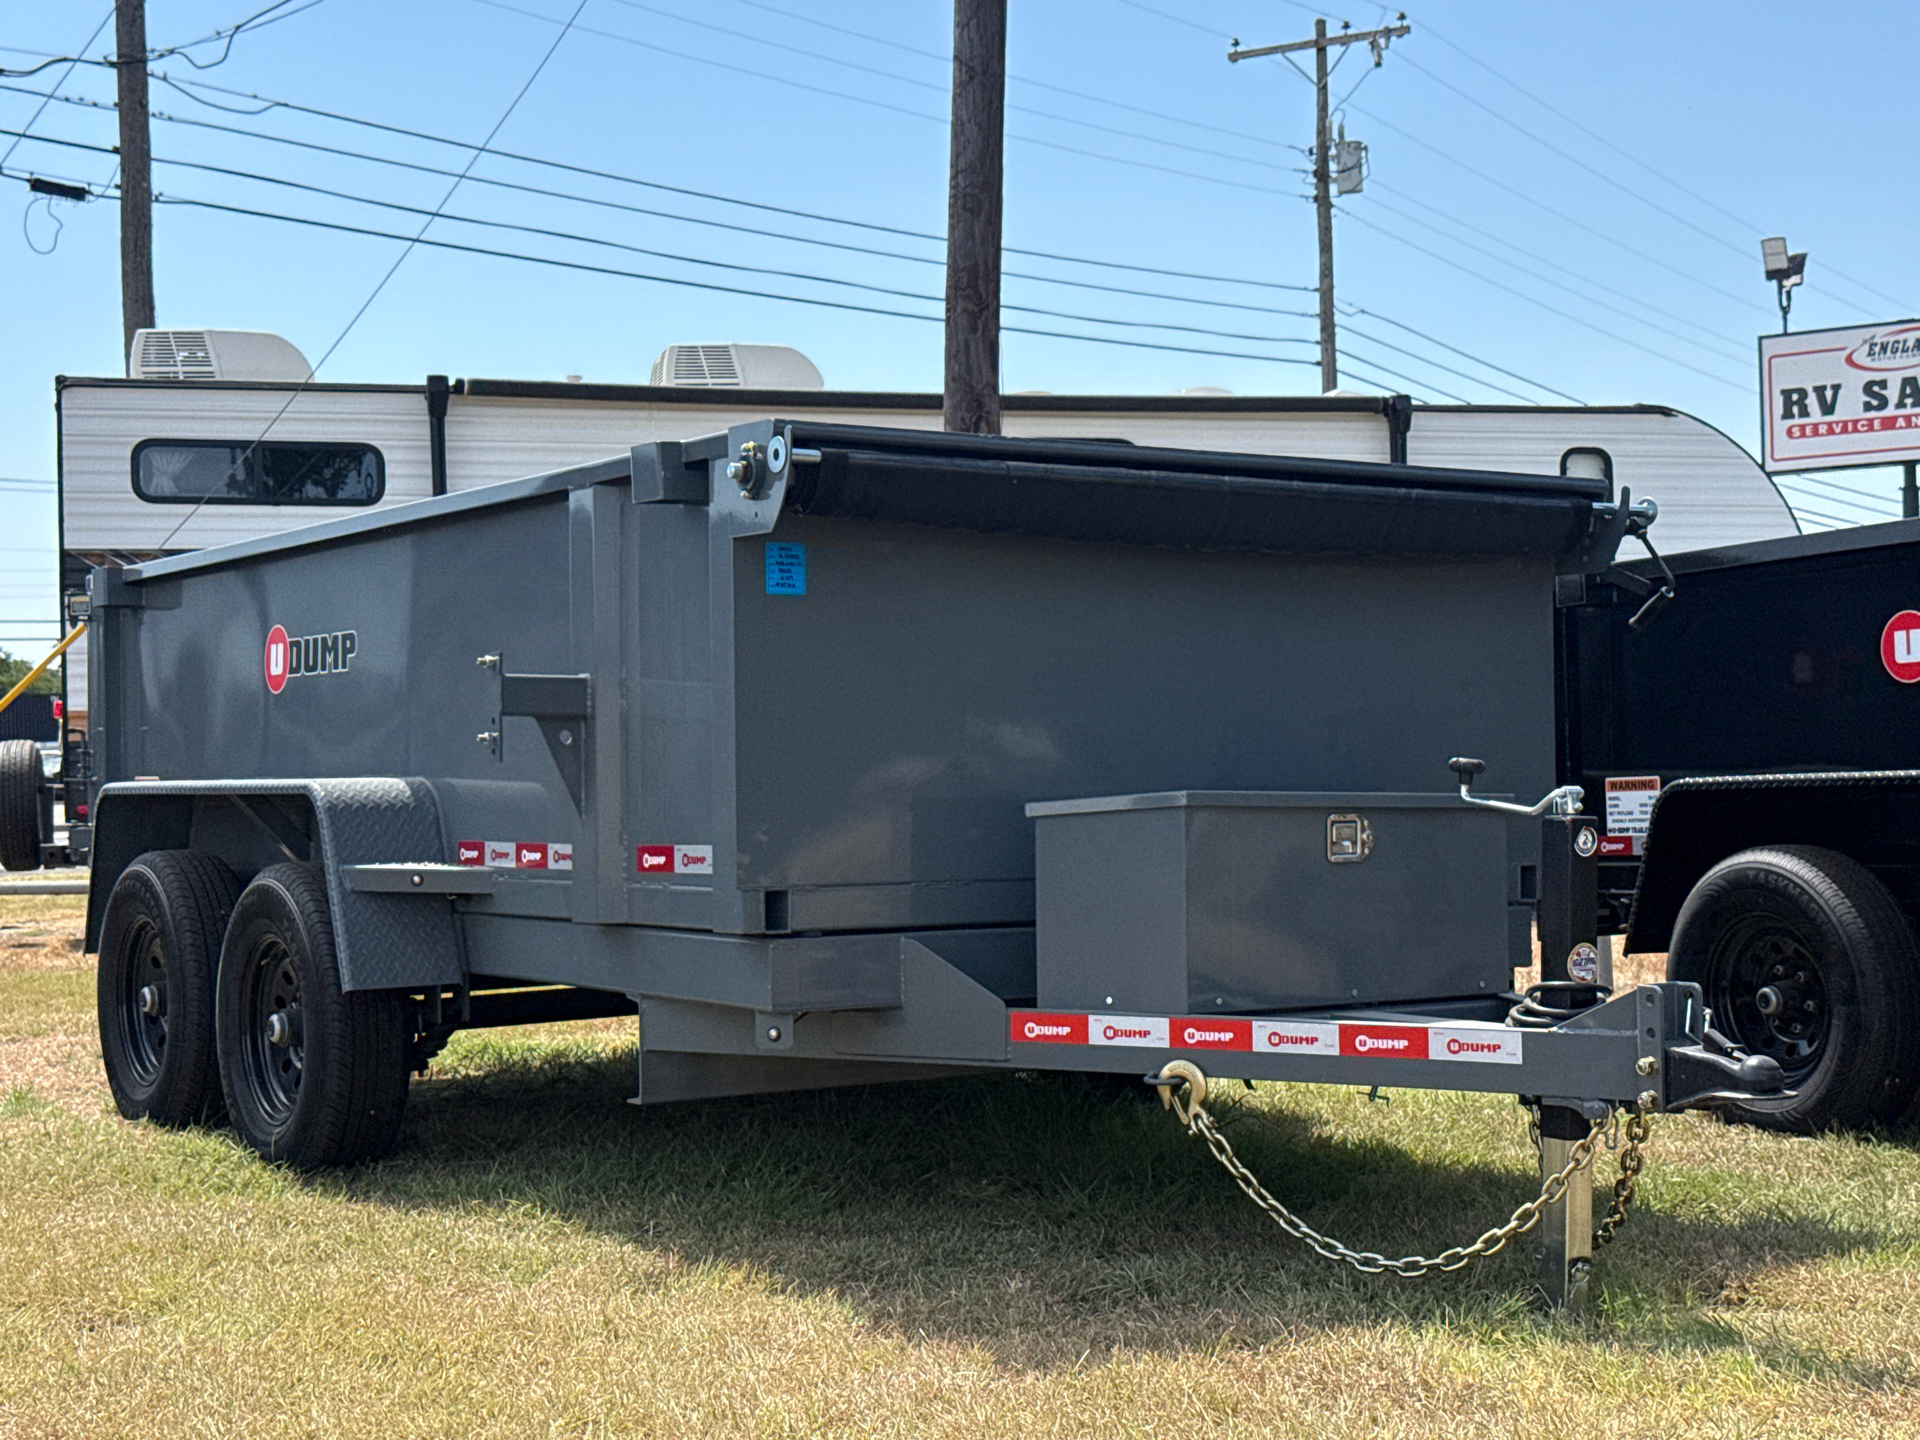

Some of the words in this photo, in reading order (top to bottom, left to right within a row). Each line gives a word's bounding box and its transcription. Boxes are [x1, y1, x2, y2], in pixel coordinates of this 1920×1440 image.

[1780, 383, 1842, 420] RV
[1790, 419, 1882, 438] SERVICE
[1609, 780, 1655, 791] WARNING
